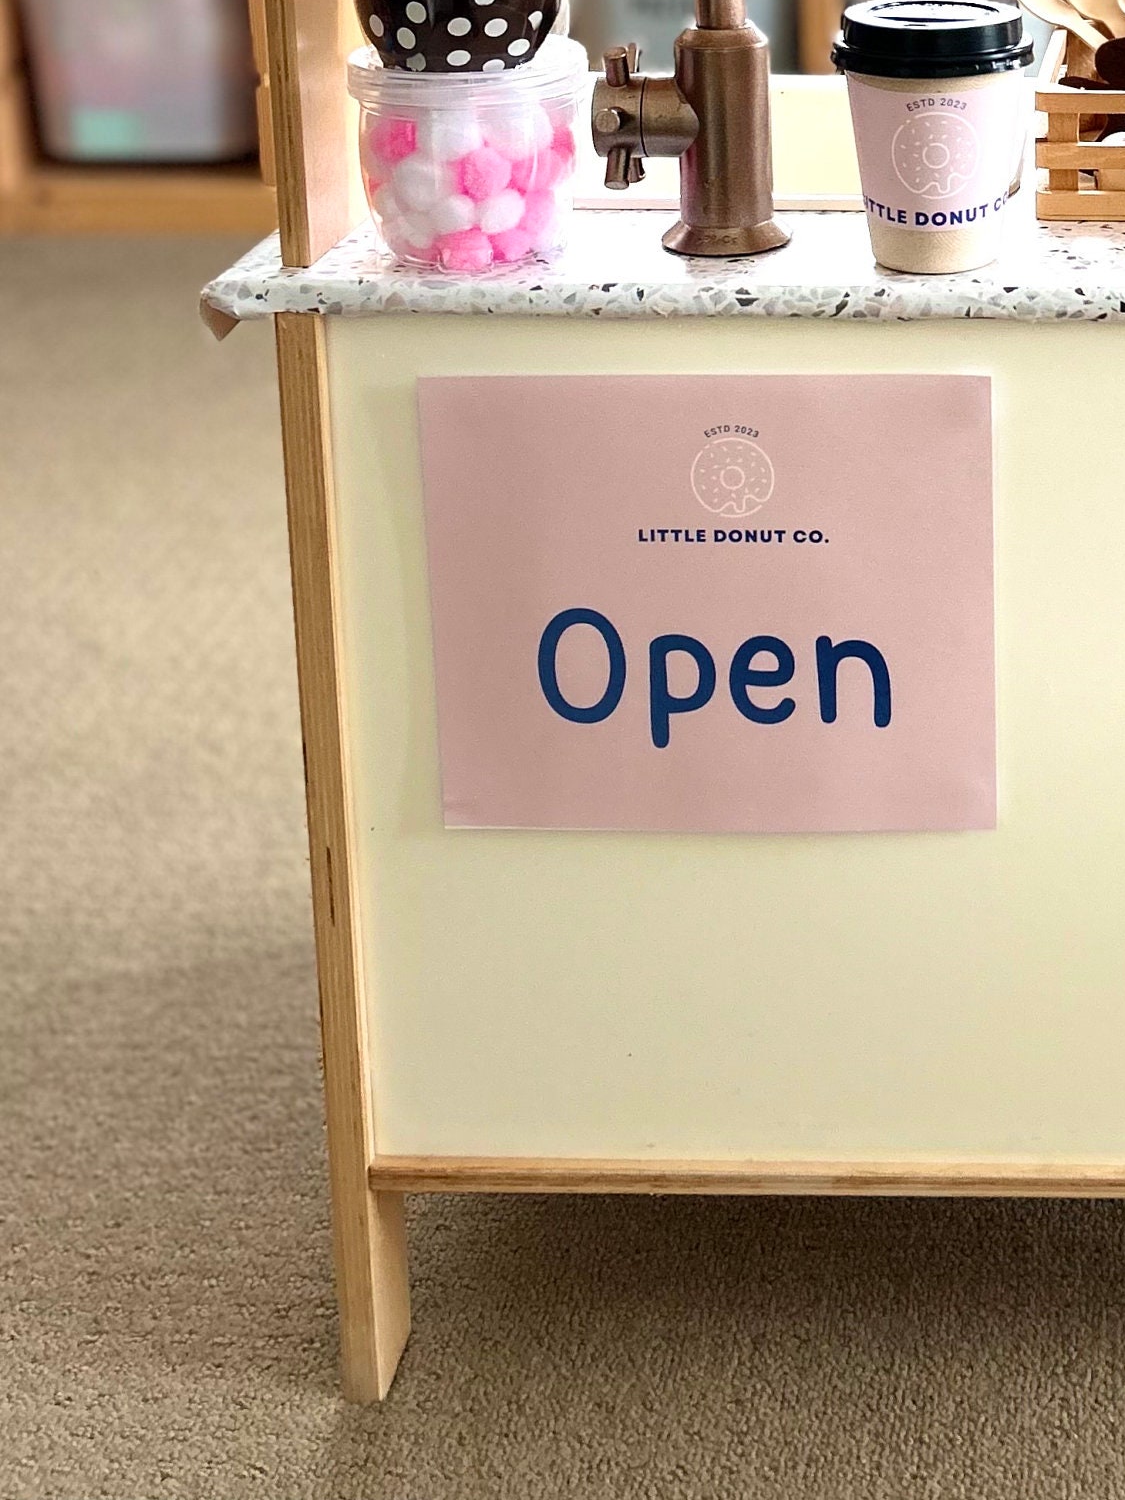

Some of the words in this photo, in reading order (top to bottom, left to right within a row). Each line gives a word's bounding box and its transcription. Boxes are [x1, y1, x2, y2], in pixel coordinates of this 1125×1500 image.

[905, 97, 936, 112] ESTD
[939, 97, 968, 112] 2023
[914, 202, 989, 227] DONUT
[702, 424, 732, 439] ESTD
[733, 424, 761, 439] 2023
[638, 528, 707, 544] LITTLE
[713, 529, 787, 544] DONUT
[792, 529, 831, 545] CO.
[537, 606, 893, 750] Open
